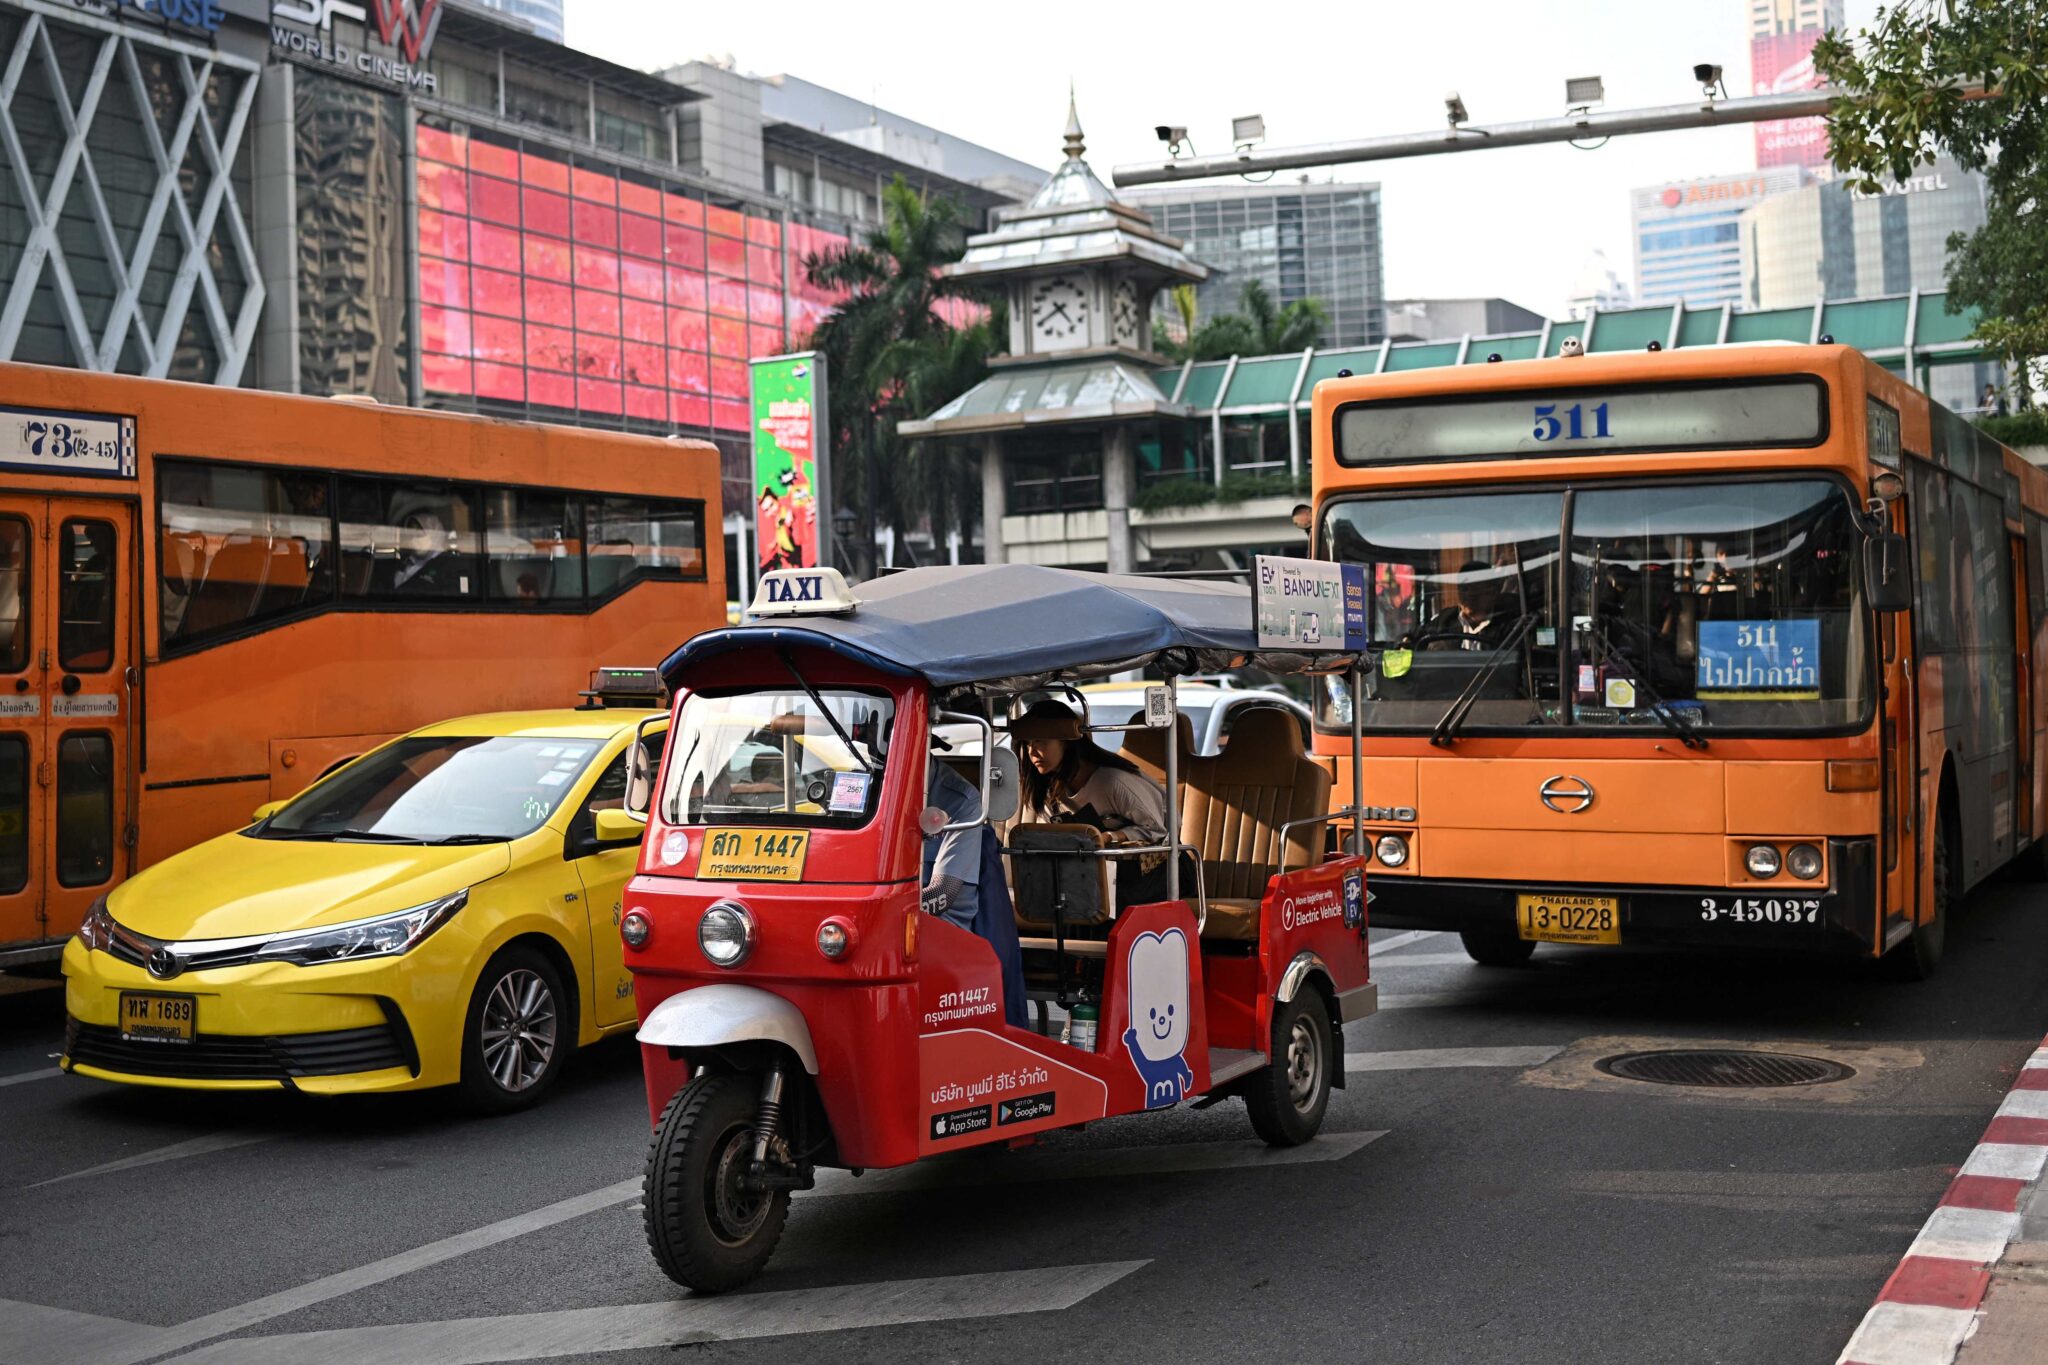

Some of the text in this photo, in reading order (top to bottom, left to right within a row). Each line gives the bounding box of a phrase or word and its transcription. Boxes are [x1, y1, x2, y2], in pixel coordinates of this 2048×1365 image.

[272, 27, 437, 91] WORLD CINEMA
[1764, 130, 1819, 150] GROUP
[1687, 178, 1765, 204] Amari
[1533, 402, 1615, 442] 511
[764, 576, 823, 602] TAXI
[1737, 624, 1776, 648] 511
[1698, 647, 1815, 687] ไปปากน้ำ
[847, 785, 863, 793] 2567
[712, 832, 804, 858] สก 1447
[709, 864, 788, 876] กรุงเทพมหานคร
[1541, 896, 1594, 906] THAILAND
[1701, 898, 1820, 923] 3-45037
[1296, 903, 1342, 927] Electric Vehicle
[1527, 905, 1613, 931] 13-0228
[157, 1000, 190, 1021] 1689
[924, 1002, 997, 1027] กรุงเทพมหานคร
[931, 1067, 1048, 1104] บริษัท มูฟมี ฮีโร่ จำกัด
[1153, 1079, 1174, 1101] m
[950, 1111, 973, 1121] Download
[1014, 1102, 1052, 1119] Google Play
[949, 1116, 987, 1133] App Store
